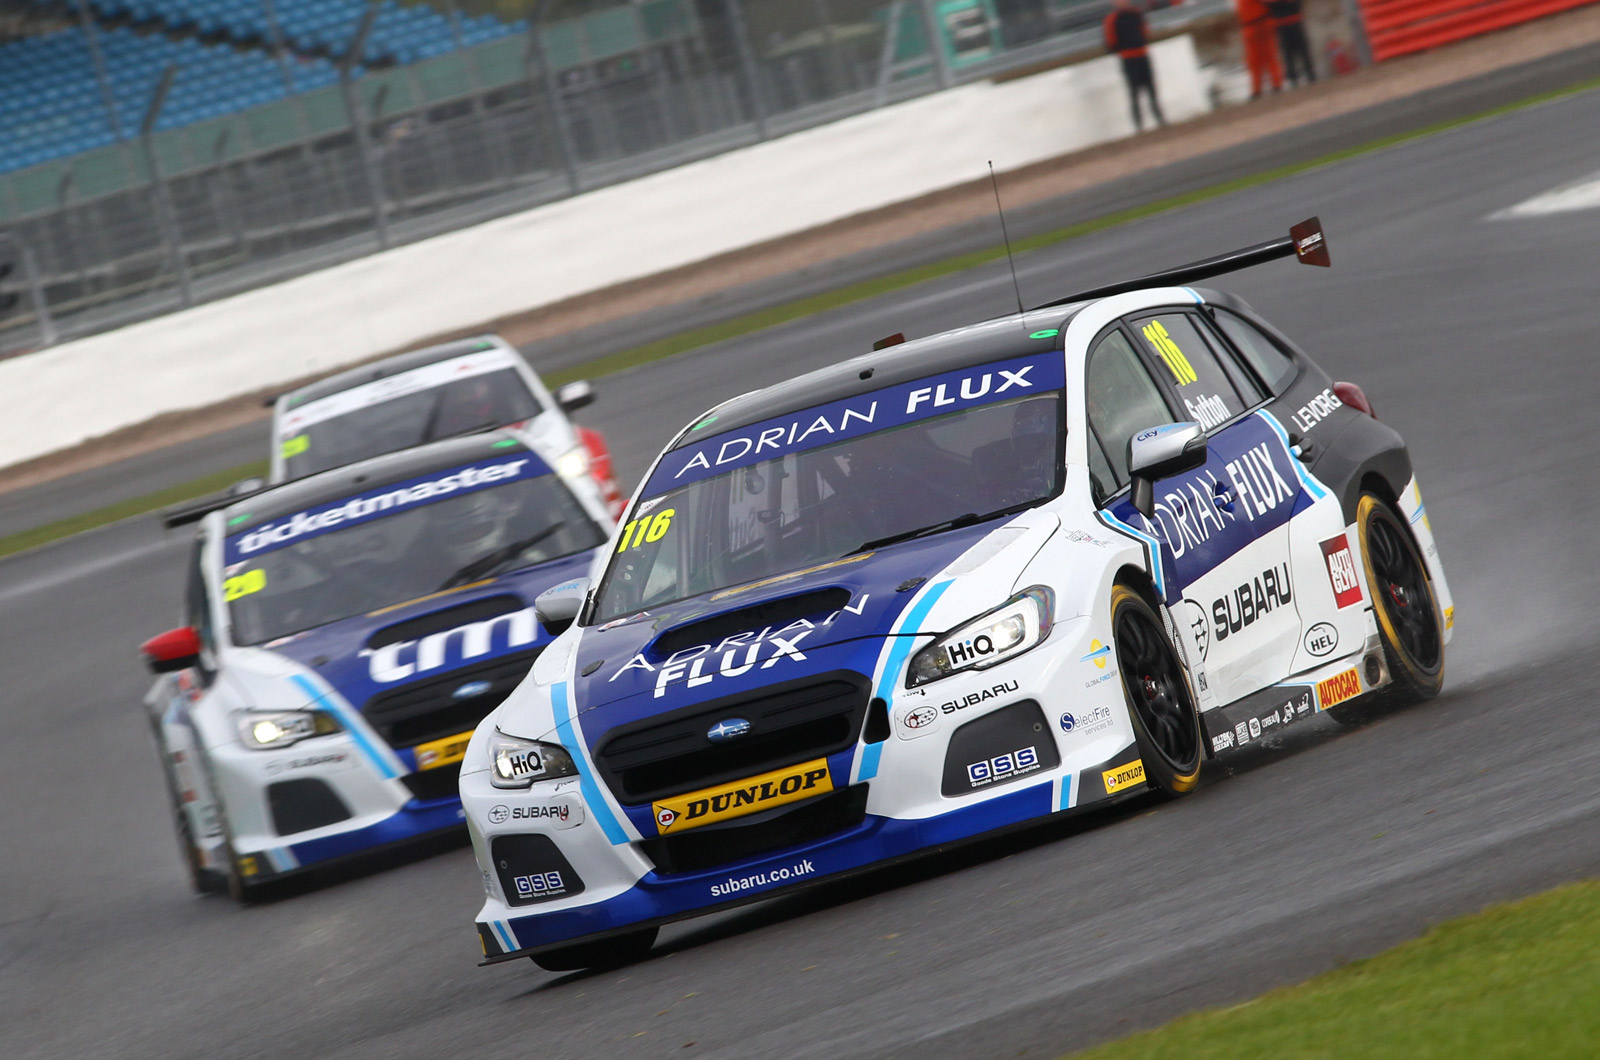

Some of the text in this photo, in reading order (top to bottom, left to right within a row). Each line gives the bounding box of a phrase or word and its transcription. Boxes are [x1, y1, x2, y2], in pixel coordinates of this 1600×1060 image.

[1142, 319, 1198, 387] 116
[674, 365, 1034, 479] ADRIAN FLUX
[1184, 394, 1232, 432] Sutton
[1291, 388, 1344, 433] LEVORG
[1225, 442, 1294, 522] FLUX
[236, 458, 528, 554] ticketmaster
[617, 508, 676, 553] 116
[1212, 562, 1292, 642] SUBARU
[357, 605, 539, 683] tm
[608, 594, 869, 682] ADRIAN
[948, 634, 995, 664] HiQ
[1310, 634, 1335, 652] HEL
[654, 630, 813, 698] FLUX
[941, 680, 1019, 715] SUBARU
[1319, 669, 1360, 708] AUTOCAR
[510, 751, 542, 775] HiQ
[968, 748, 1037, 780] GSS
[1117, 765, 1143, 784] DUNLOP
[512, 804, 569, 819] SUBARU
[685, 768, 827, 820] DUNLOP
[515, 872, 563, 893] GSS
[710, 859, 815, 897] subaru.co.uk
